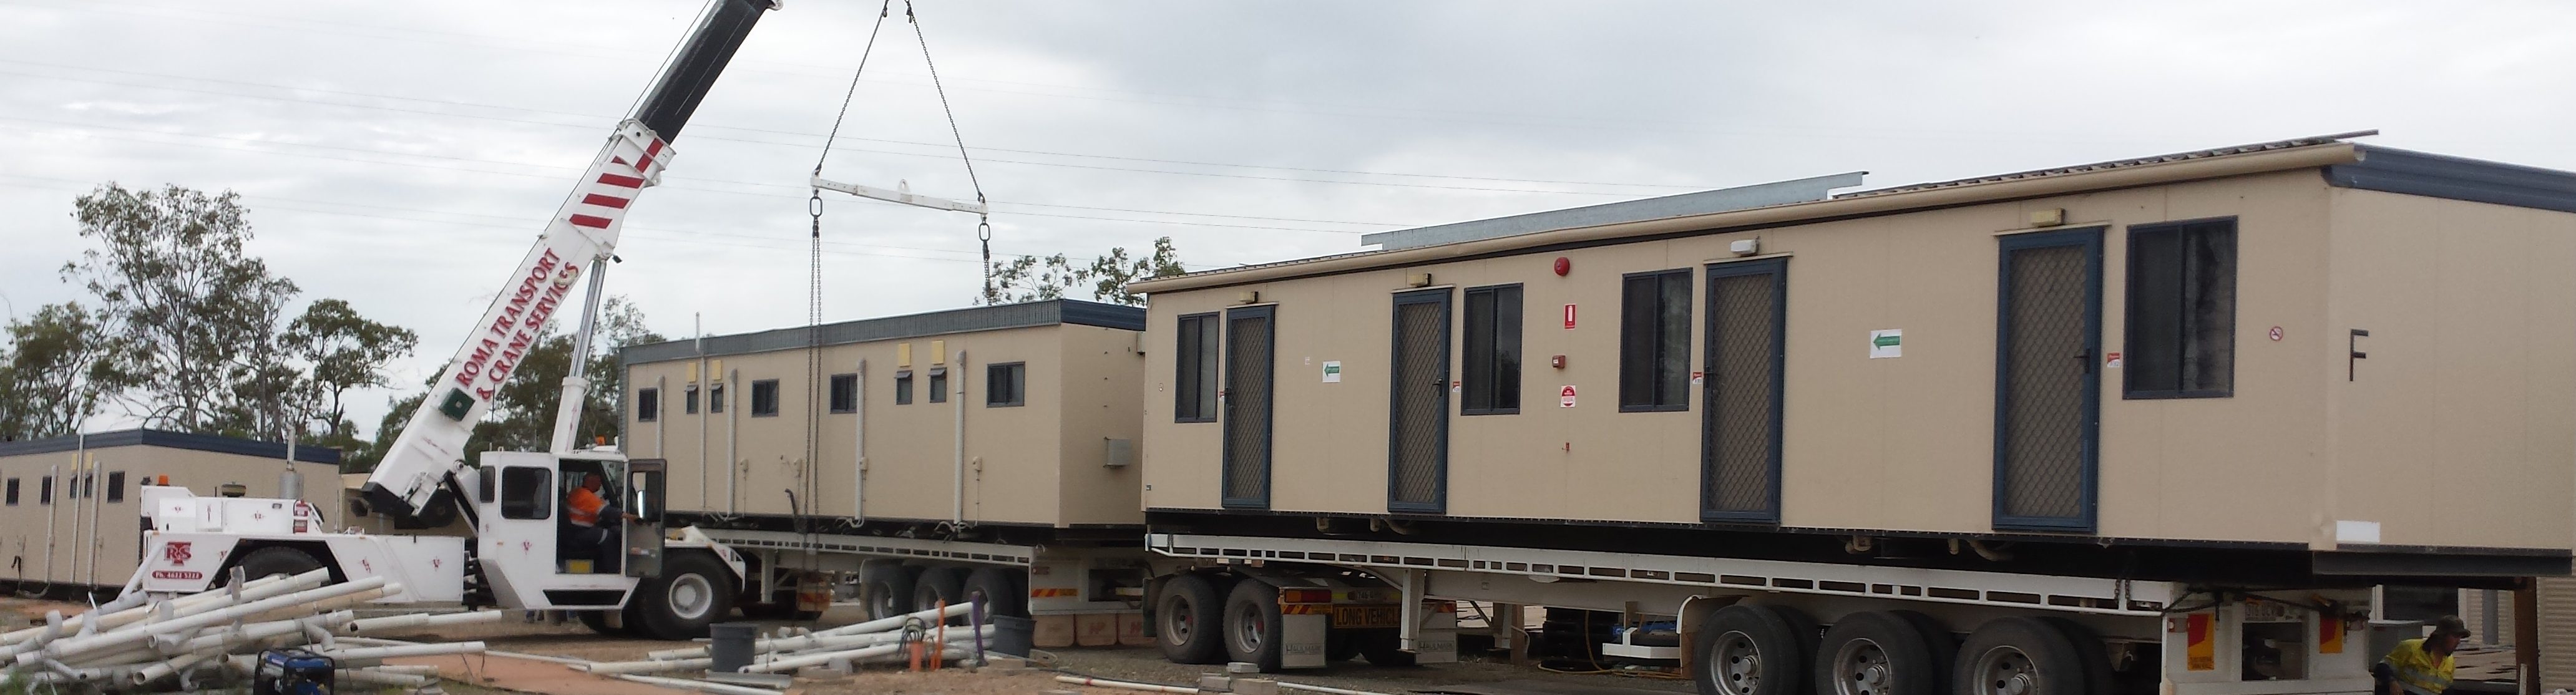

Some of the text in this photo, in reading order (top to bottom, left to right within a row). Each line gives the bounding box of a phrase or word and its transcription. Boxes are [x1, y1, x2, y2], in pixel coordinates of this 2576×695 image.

[456, 248, 560, 389] ROMA TRANSPORT
[476, 387, 495, 402] &
[489, 329, 532, 384] CRANE
[2349, 329, 2368, 381] F
[1337, 608, 1362, 625] LONG
[1364, 608, 1400, 625] VEHICL
